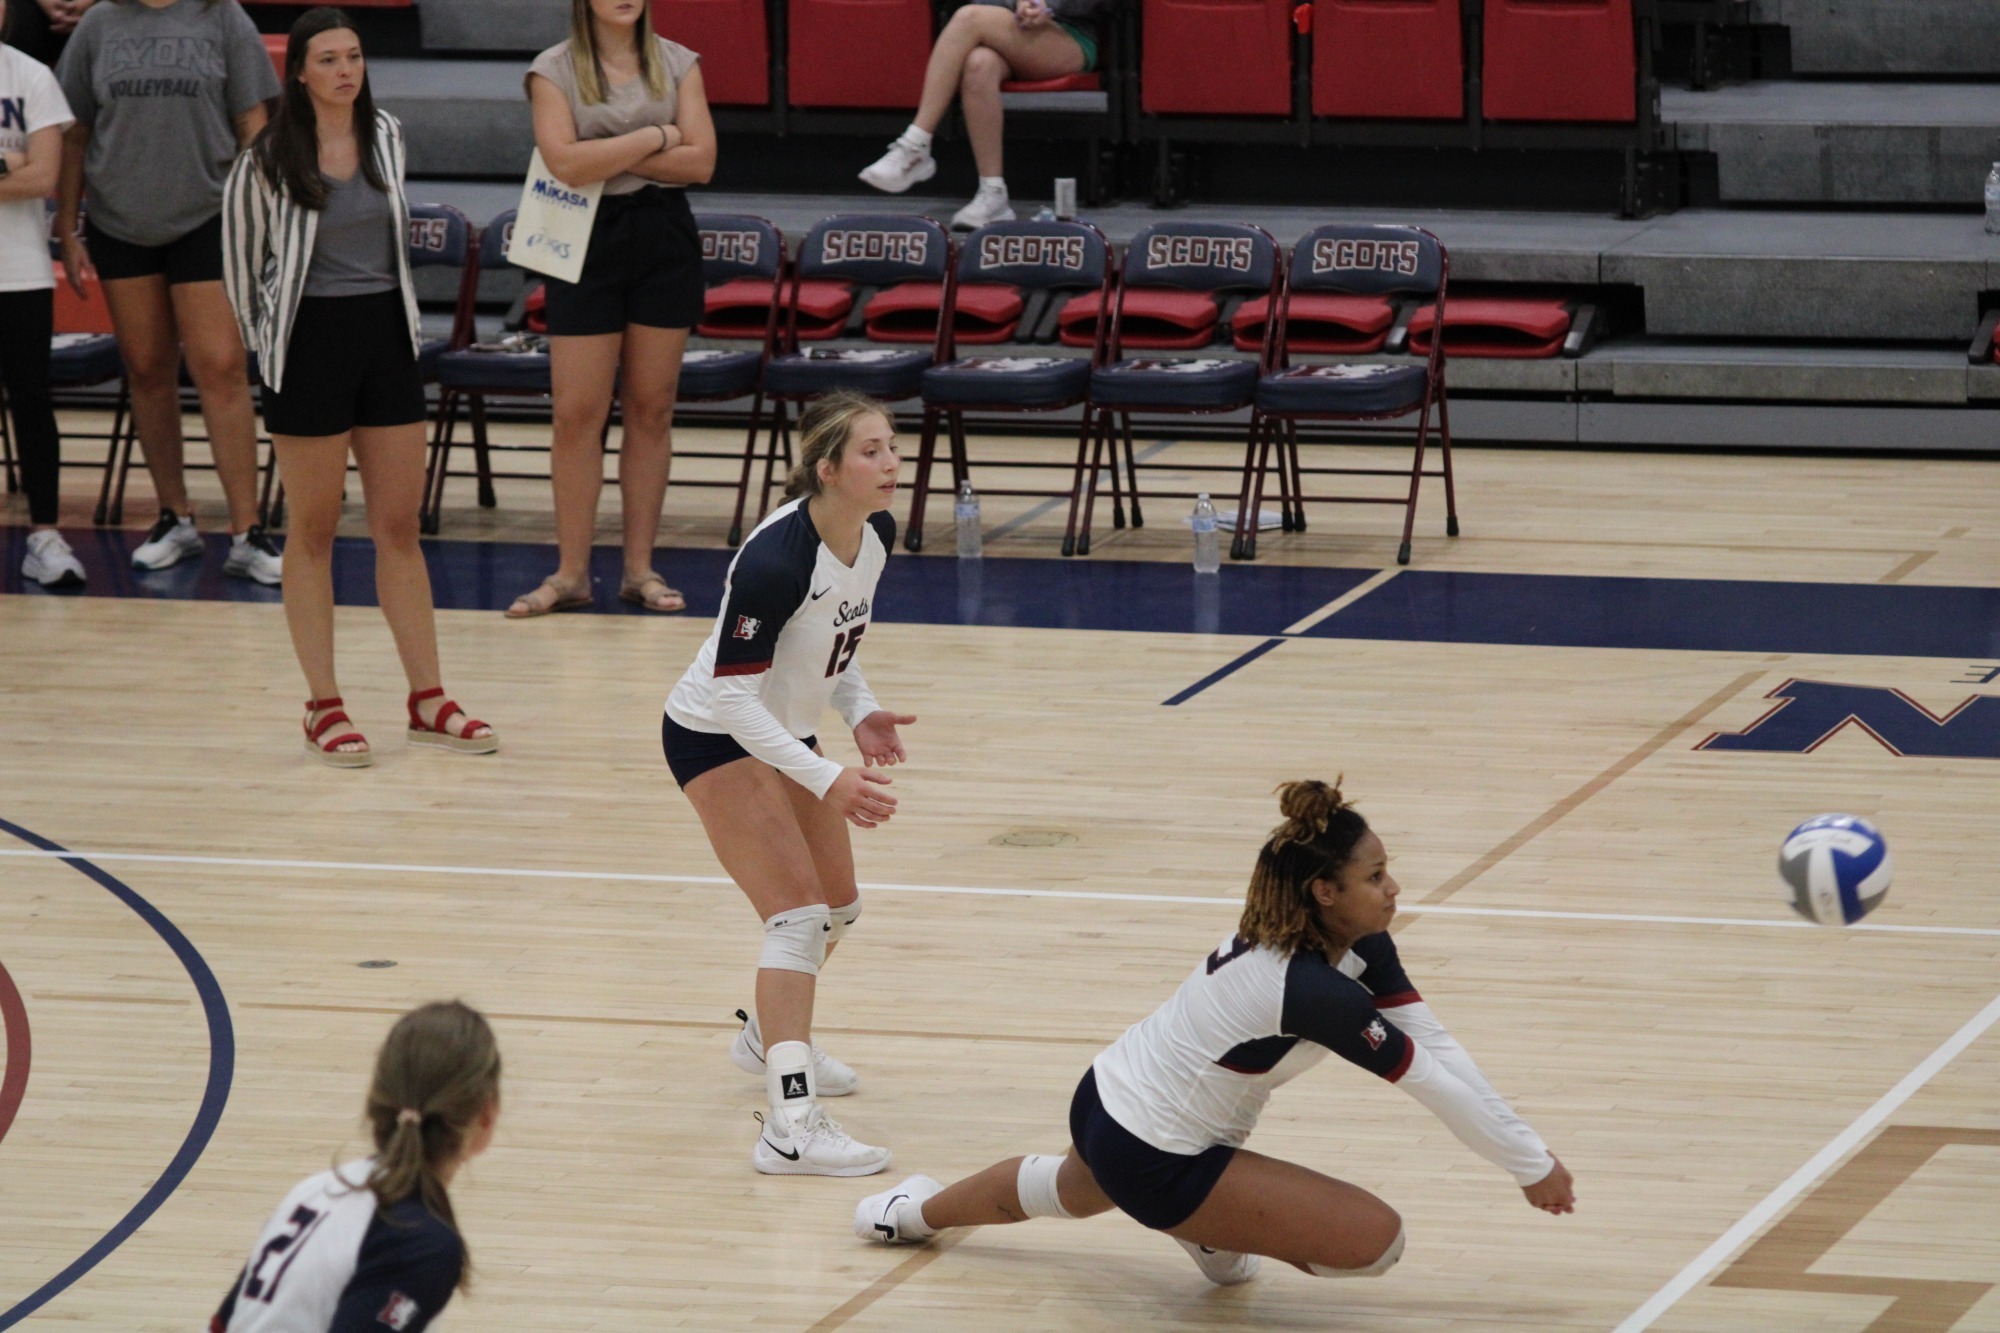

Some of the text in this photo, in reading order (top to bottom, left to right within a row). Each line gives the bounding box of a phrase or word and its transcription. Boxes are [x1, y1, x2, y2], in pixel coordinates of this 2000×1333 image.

[103, 36, 218, 80] LYON
[108, 78, 201, 99] VOLLEYBALL
[698, 229, 761, 266] OTS
[822, 230, 928, 265] SCOTS
[980, 235, 1085, 270] SCOTS
[1147, 235, 1253, 272] SCOTS
[1312, 238, 1419, 276] SCOTS
[833, 598, 869, 627] Scots
[825, 622, 866, 678] 15
